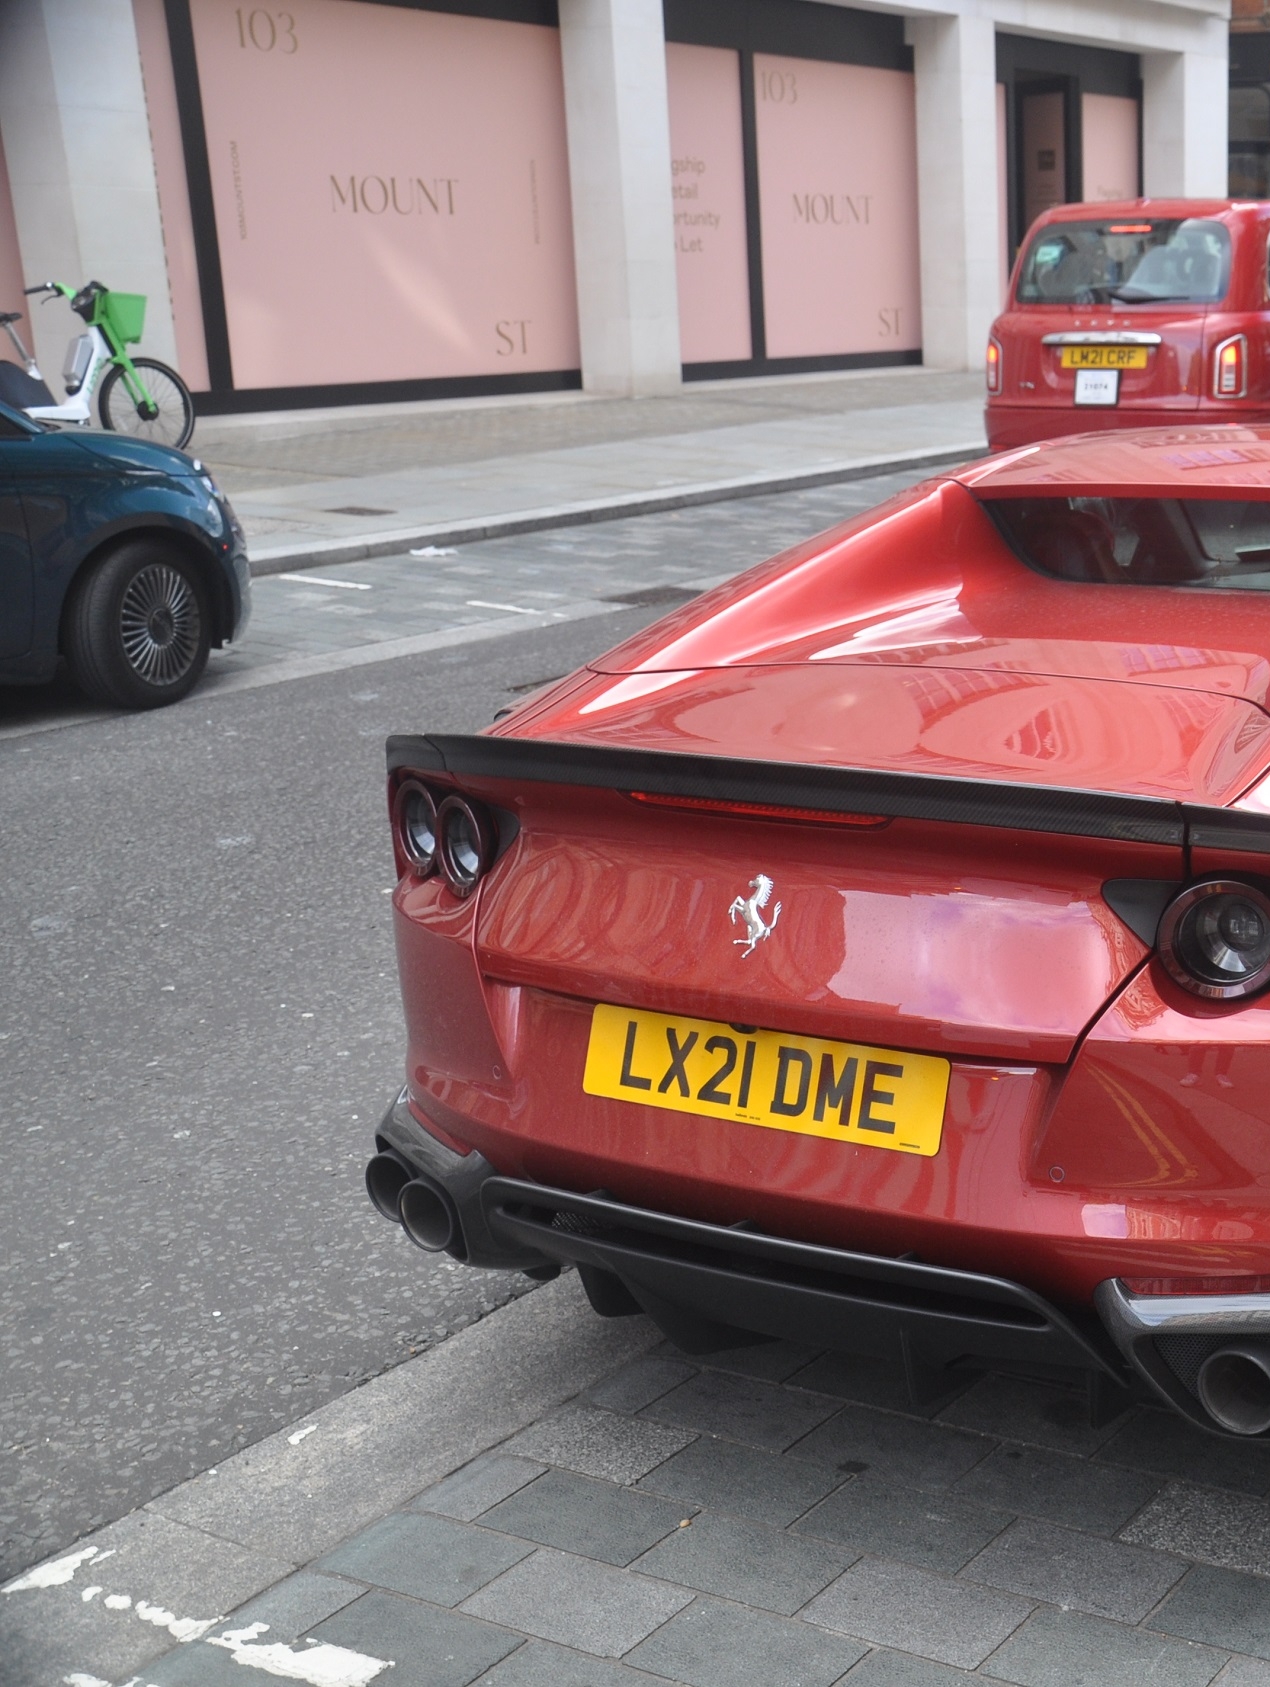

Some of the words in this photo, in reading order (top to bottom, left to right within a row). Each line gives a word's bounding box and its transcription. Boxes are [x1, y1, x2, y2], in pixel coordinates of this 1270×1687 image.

[234, 8, 299, 54] 103
[761, 70, 798, 104] 103
[329, 174, 459, 216] MOUNT
[793, 193, 873, 225] MOUNT
[680, 235, 704, 252] Let
[495, 320, 531, 357] ST
[878, 308, 902, 337] ST
[1070, 351, 1103, 365] LM21
[1107, 351, 1137, 365] CRF
[619, 1020, 757, 1108] LX21
[769, 1045, 904, 1135] DME
